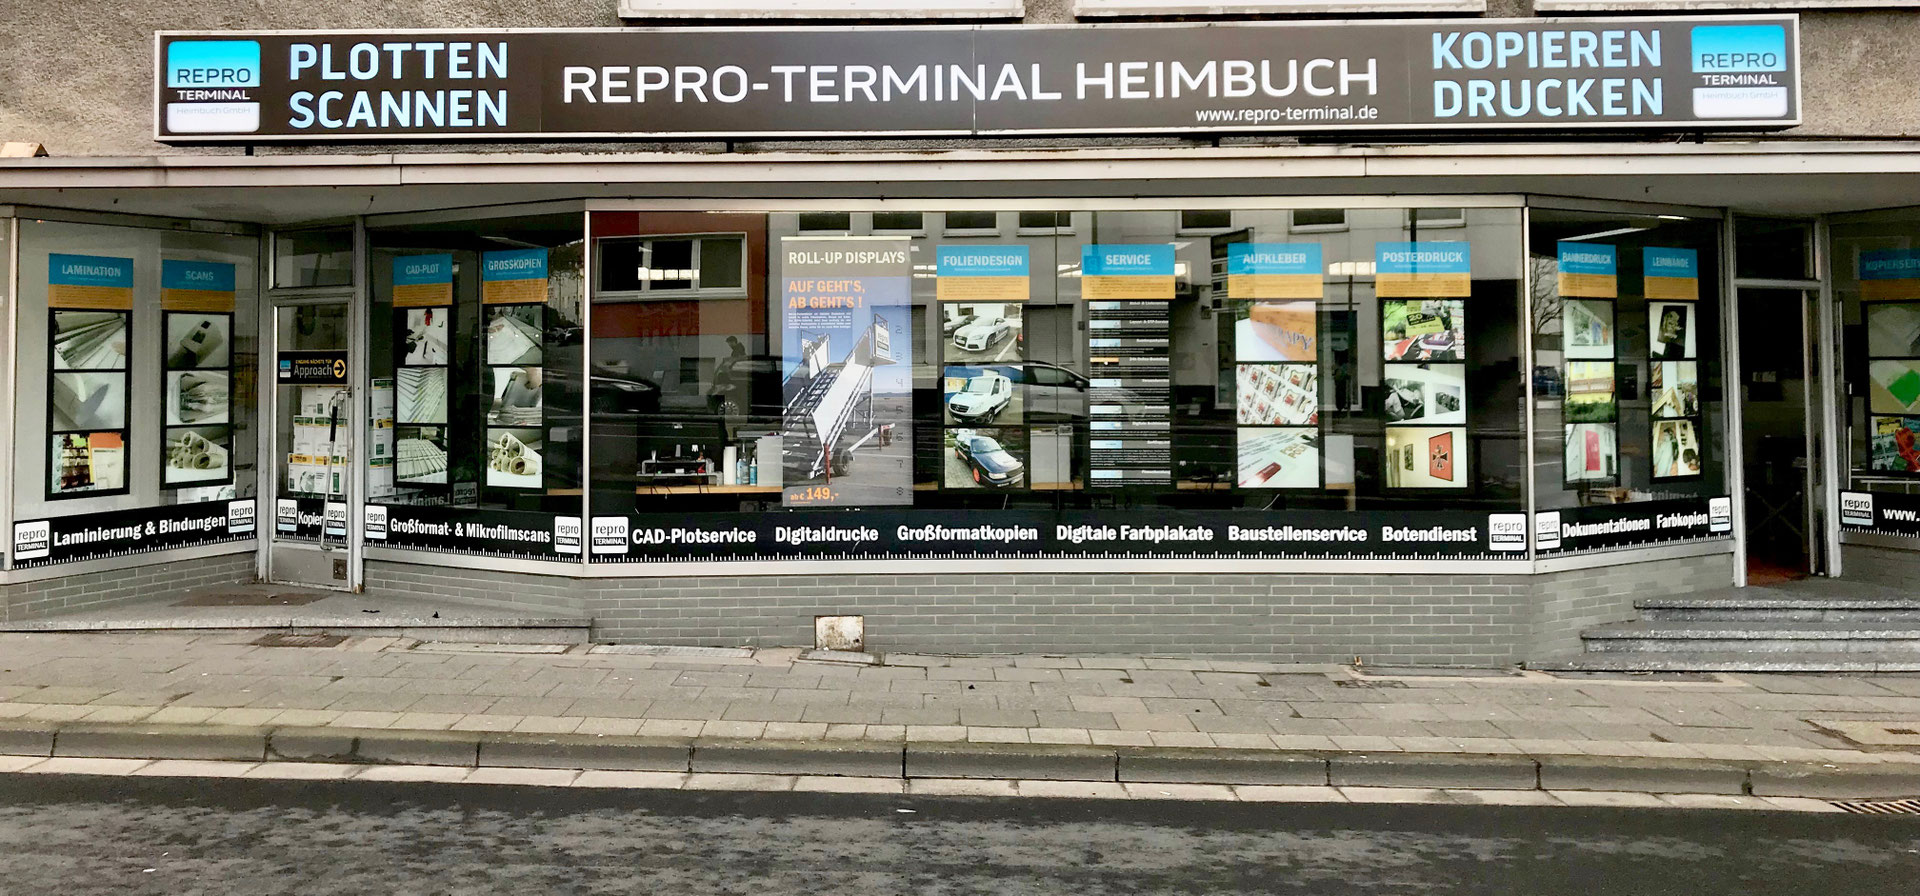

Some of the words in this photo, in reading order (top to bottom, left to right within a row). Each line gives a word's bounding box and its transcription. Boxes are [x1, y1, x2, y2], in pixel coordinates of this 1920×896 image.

[1432, 30, 1661, 70] KOPIEREN
[290, 42, 508, 80] PLOTTEN
[1701, 52, 1776, 68] REPRO
[177, 68, 251, 83] REPRO
[563, 63, 1061, 104] REPRO-TERMINAL
[1077, 58, 1378, 99] HEIMBUCH
[1702, 74, 1777, 85] TERMINAL
[177, 90, 250, 100] TERMINAL
[1433, 78, 1663, 118] DRUCKEN
[289, 90, 508, 128] SCANNEN
[1196, 105, 1378, 124] www.repro-terminal.de
[789, 252, 842, 264] ROLL-UP
[845, 251, 905, 263] DISPLAYS
[943, 255, 1022, 266] FOLIENDESIGN
[1105, 254, 1151, 265] SERVICE
[1243, 253, 1307, 264] AUFKLEBER
[1383, 252, 1463, 263] POSTERDRUCK
[1562, 252, 1612, 265] BANNERDRUCK
[62, 264, 121, 277] LAMINATION
[406, 263, 440, 275] CAD-PLOT
[488, 258, 542, 271] GROSSKOPIEN
[185, 270, 214, 281] SCANS
[789, 280, 814, 292] AUF
[817, 280, 866, 294] GEHT'S,
[789, 296, 806, 308] AB
[809, 296, 855, 309] GEHT'S
[293, 365, 333, 378] Approach
[280, 506, 295, 515] repro
[1845, 499, 1870, 509] repro
[231, 506, 253, 517] repro
[327, 510, 345, 519] repro
[367, 512, 385, 522] repro
[54, 522, 142, 546] Laminierung
[145, 521, 156, 535] &
[160, 516, 226, 533] Bindungen
[391, 518, 453, 536] Großformat-
[455, 522, 464, 536] &
[466, 522, 550, 543] Mikrofilmscans
[557, 524, 579, 535] repro
[595, 524, 626, 536] repro
[1493, 522, 1523, 533] repro
[1562, 517, 1650, 538] Dokumentationen
[1656, 511, 1708, 529] Farbkopien
[18, 529, 46, 541] repro
[632, 528, 756, 544] CAD-Plotservice
[775, 526, 879, 545] Digitaldrucke
[897, 525, 1038, 543] Großformatkopien
[1056, 525, 1116, 543] Digitale
[1120, 525, 1213, 543] Farbplakate
[1228, 526, 1367, 542] Baustellenservice
[1382, 526, 1477, 542] Botendienst
[17, 542, 46, 551] TERMINAL
